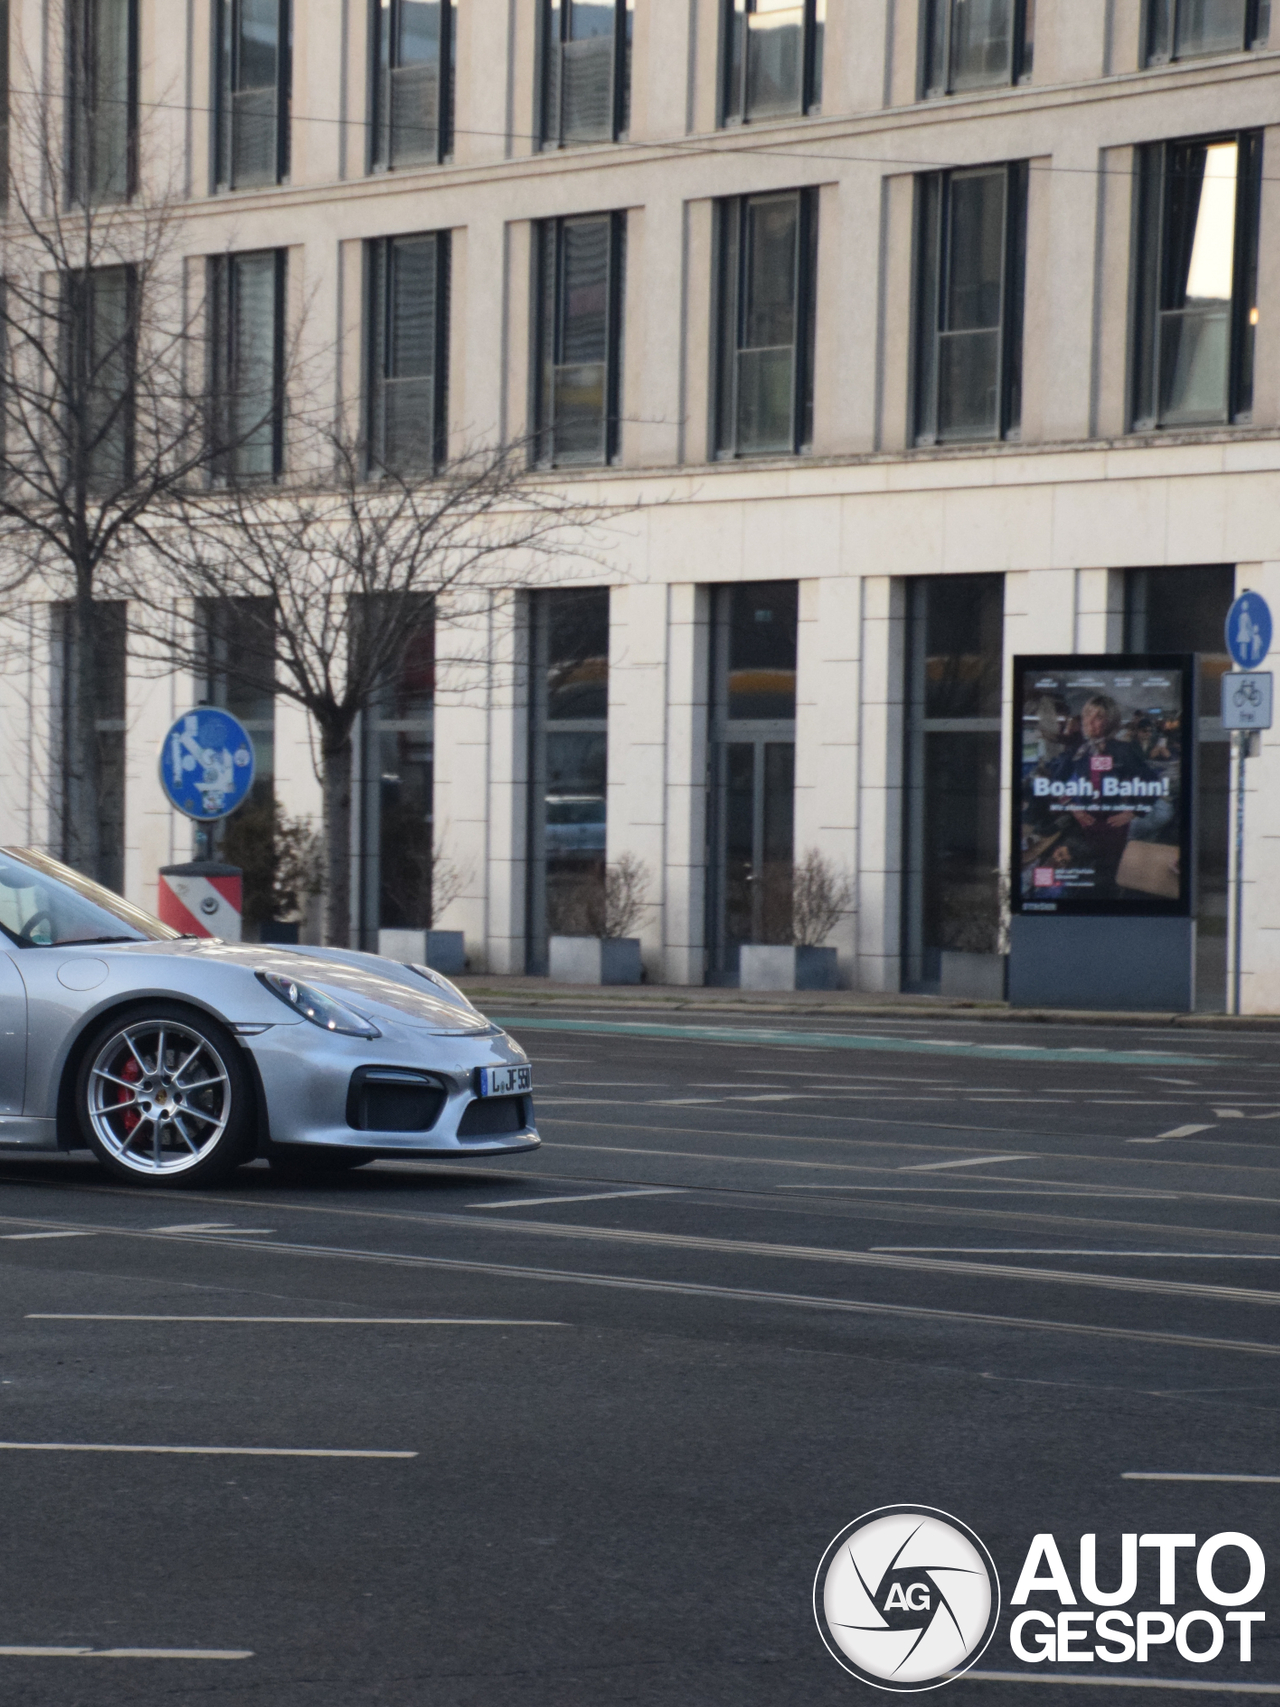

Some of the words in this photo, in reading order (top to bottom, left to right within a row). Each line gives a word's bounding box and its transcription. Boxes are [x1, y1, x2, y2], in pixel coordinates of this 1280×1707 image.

[1033, 777, 1100, 799] Boah,
[1102, 777, 1170, 796] Bahn!
[492, 1070, 500, 1092] L
[506, 1069, 517, 1091] JF
